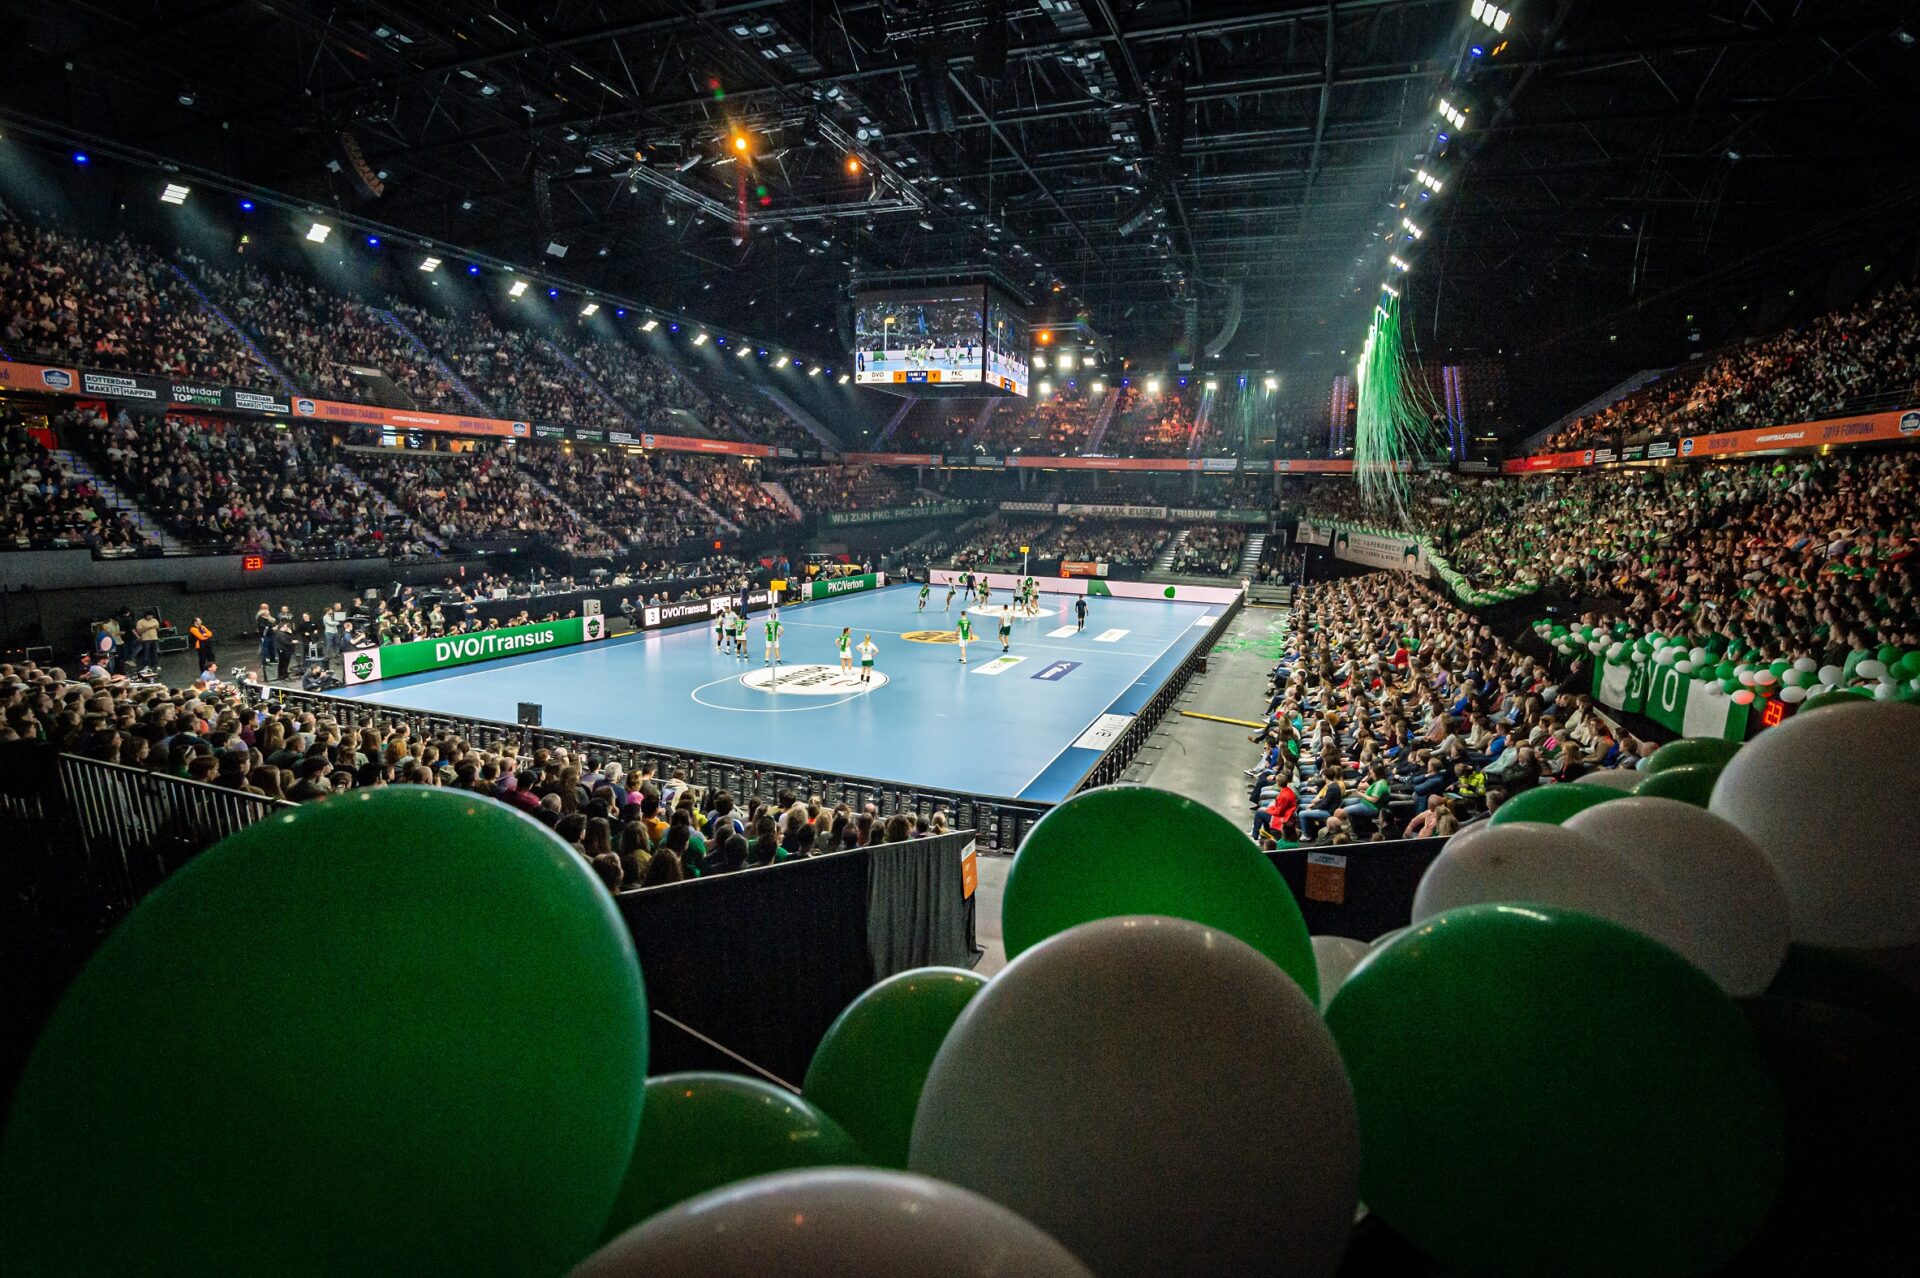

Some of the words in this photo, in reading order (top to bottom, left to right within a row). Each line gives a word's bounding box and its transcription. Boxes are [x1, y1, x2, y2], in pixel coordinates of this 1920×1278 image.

[86, 375, 136, 387] ROTTERDAM.
[87, 384, 111, 393] MAKE
[123, 389, 156, 398] HAPPEN.
[172, 385, 222, 397] rotterdam
[173, 392, 222, 406] TOPSPORT
[832, 513, 848, 523] WIJ
[850, 512, 871, 522] ZIJN
[895, 509, 911, 518] PKC
[1092, 507, 1125, 517] SJAAK
[1129, 507, 1163, 518] EUSER
[246, 557, 261, 569] 23
[828, 579, 864, 593] PKC/Vertom
[661, 603, 709, 619] DVO/Transus
[435, 629, 554, 662] DVO/Transus
[352, 661, 374, 672] DVO
[1765, 700, 1782, 727] 23
